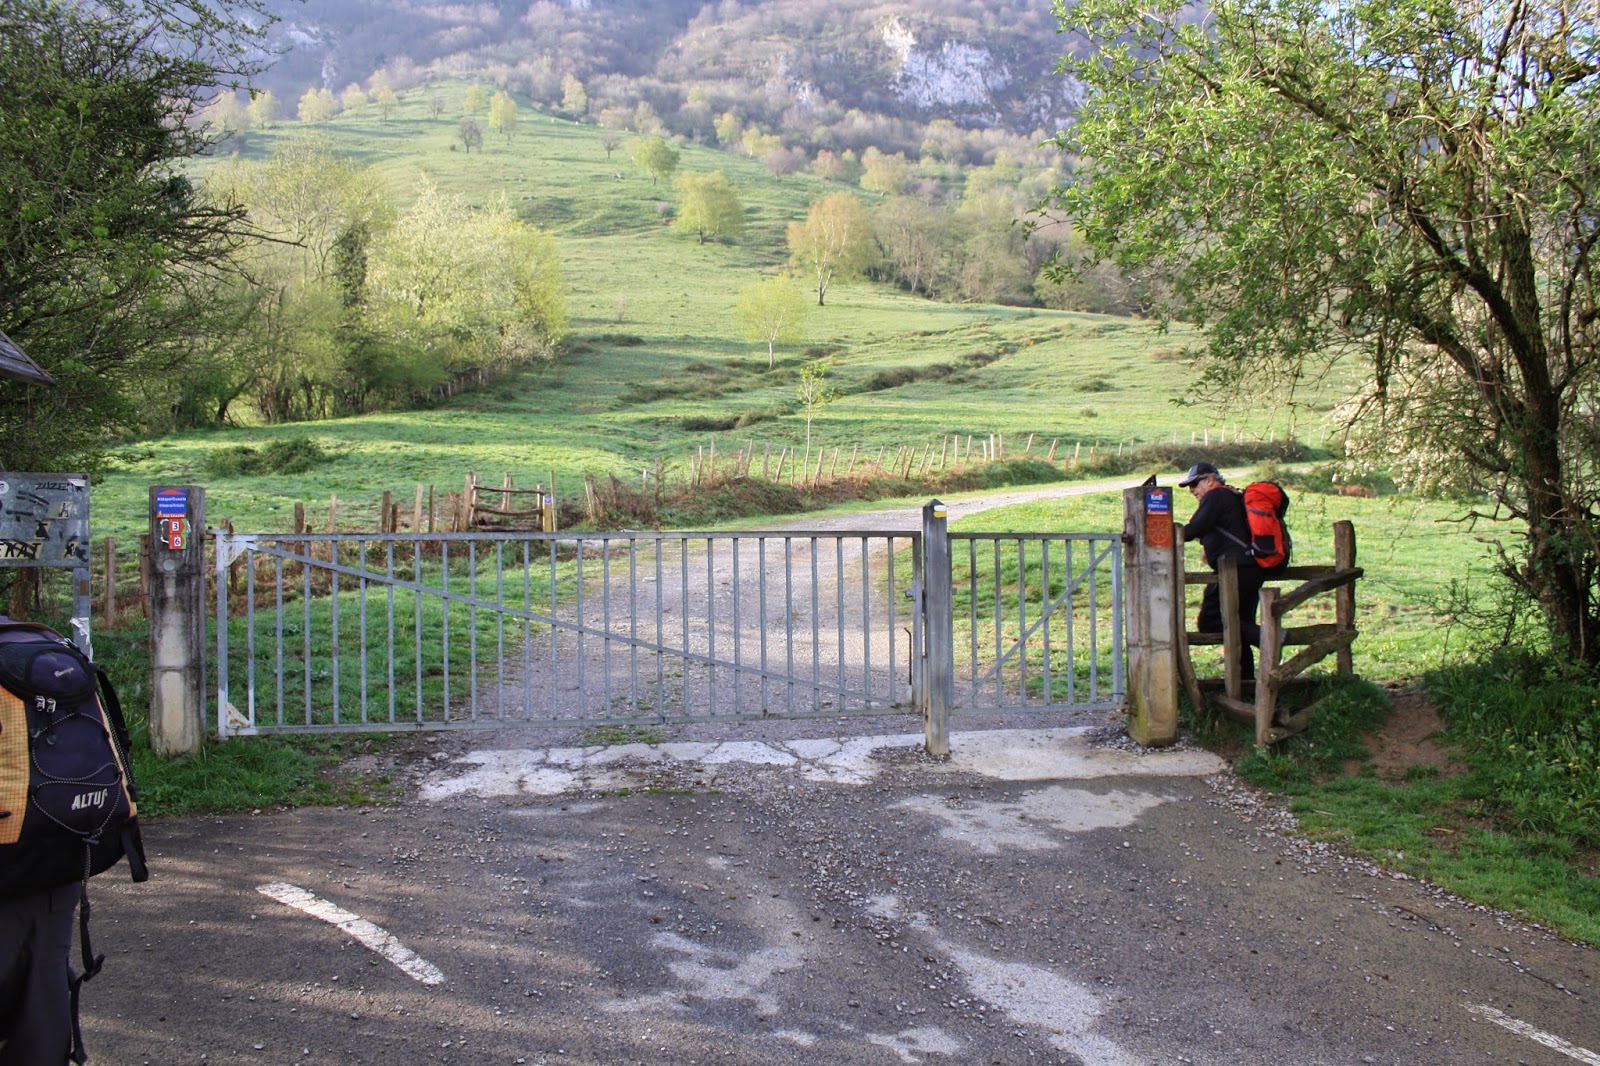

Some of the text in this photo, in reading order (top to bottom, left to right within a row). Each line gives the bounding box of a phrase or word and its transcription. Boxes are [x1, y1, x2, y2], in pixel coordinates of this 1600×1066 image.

[173, 522, 179, 530] 3
[174, 537, 181, 546] 6
[71, 787, 108, 811] ALTUS
